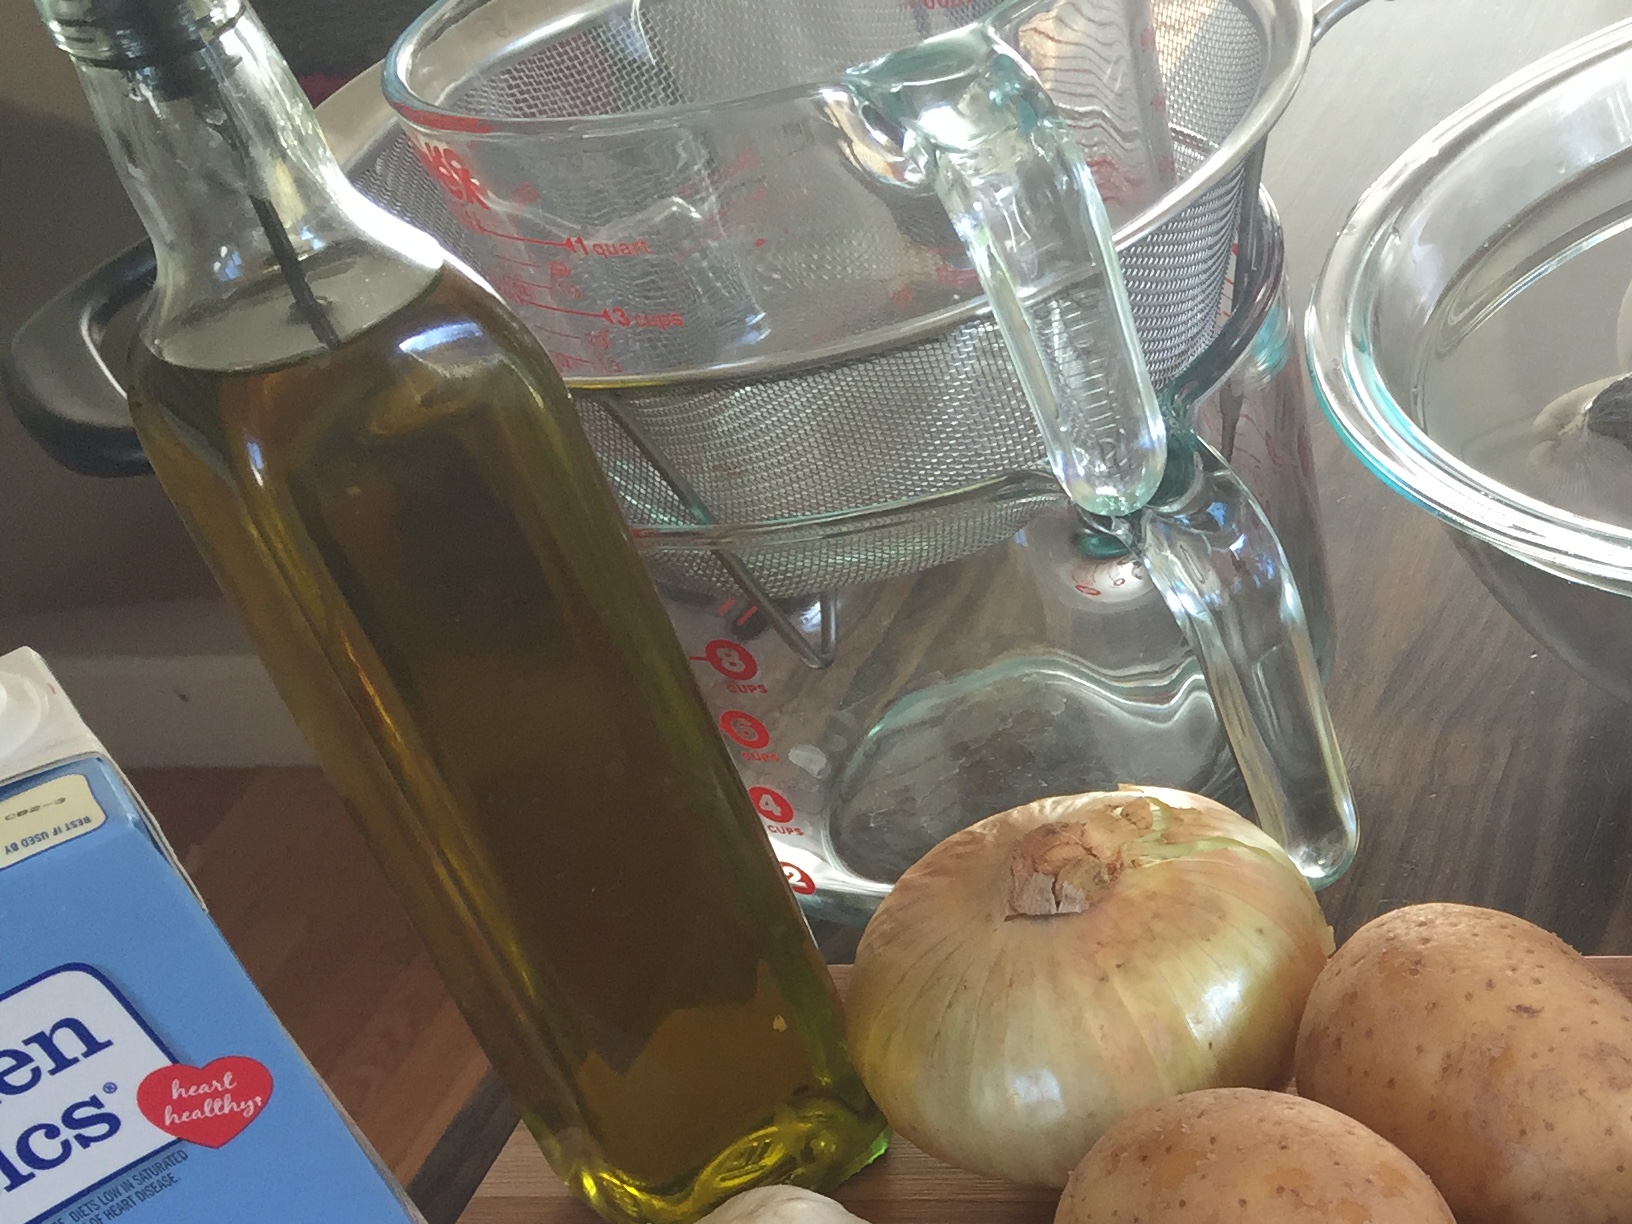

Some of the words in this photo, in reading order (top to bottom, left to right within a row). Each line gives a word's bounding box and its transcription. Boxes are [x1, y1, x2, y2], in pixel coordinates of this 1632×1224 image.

[592, 238, 652, 259] quart
[633, 312, 685, 331] cups
[726, 683, 768, 695] CUPS
[741, 752, 780, 763] CUPS
[52, 825, 63, 837] IF
[64, 815, 92, 832] BEST
[767, 824, 805, 837] CUPS
[20, 831, 50, 848] USED
[4, 842, 20, 855] BY
[171, 1071, 237, 1100] heart
[68, 1200, 101, 1222] DIETS
[97, 1186, 123, 1205] LOW
[119, 1180, 135, 1195] IN
[134, 1149, 189, 1186] SATURATED
[103, 1198, 137, 1221] HEART
[135, 1173, 181, 1203] DISEASE.
